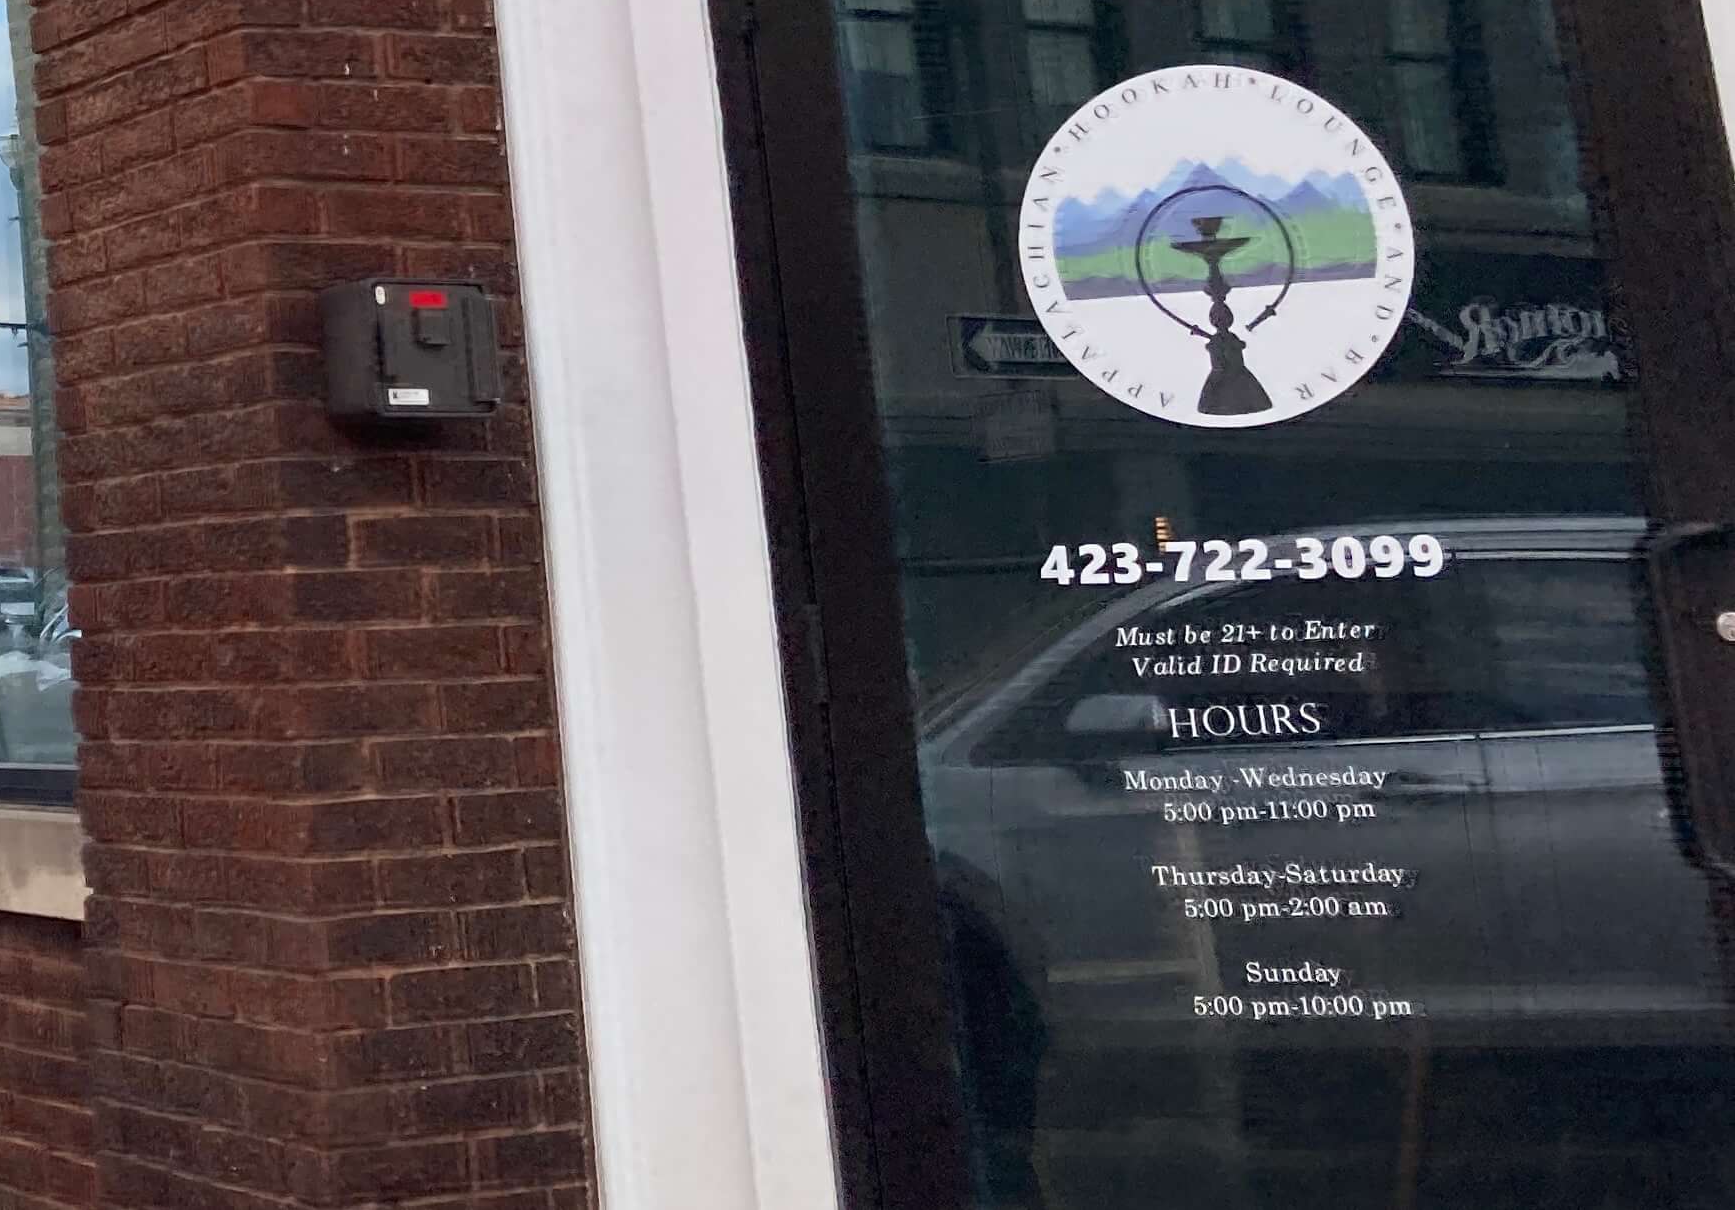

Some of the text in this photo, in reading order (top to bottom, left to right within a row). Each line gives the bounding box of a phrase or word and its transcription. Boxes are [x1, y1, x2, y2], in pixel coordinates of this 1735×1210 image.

[1026, 73, 1405, 409] HOOKAH LOUNGE AND BAR APPALACHIAN
[1041, 534, 1445, 586] 423-722-3099
[1115, 620, 1376, 647] Must be 21+ to Enter
[1132, 651, 1365, 677] Valid ID Required
[1168, 702, 1322, 739] HOURS
[1124, 769, 1223, 793] Monday
[1164, 800, 1376, 826] 5:00 pm-11:00 pm
[1152, 862, 1405, 888] Thursday-Saturday
[1184, 897, 1388, 921] 5:00 pm-2:00 am
[1245, 961, 1342, 987] Sunday
[1193, 995, 1413, 1020] 5:00 pm-10:00 pm
